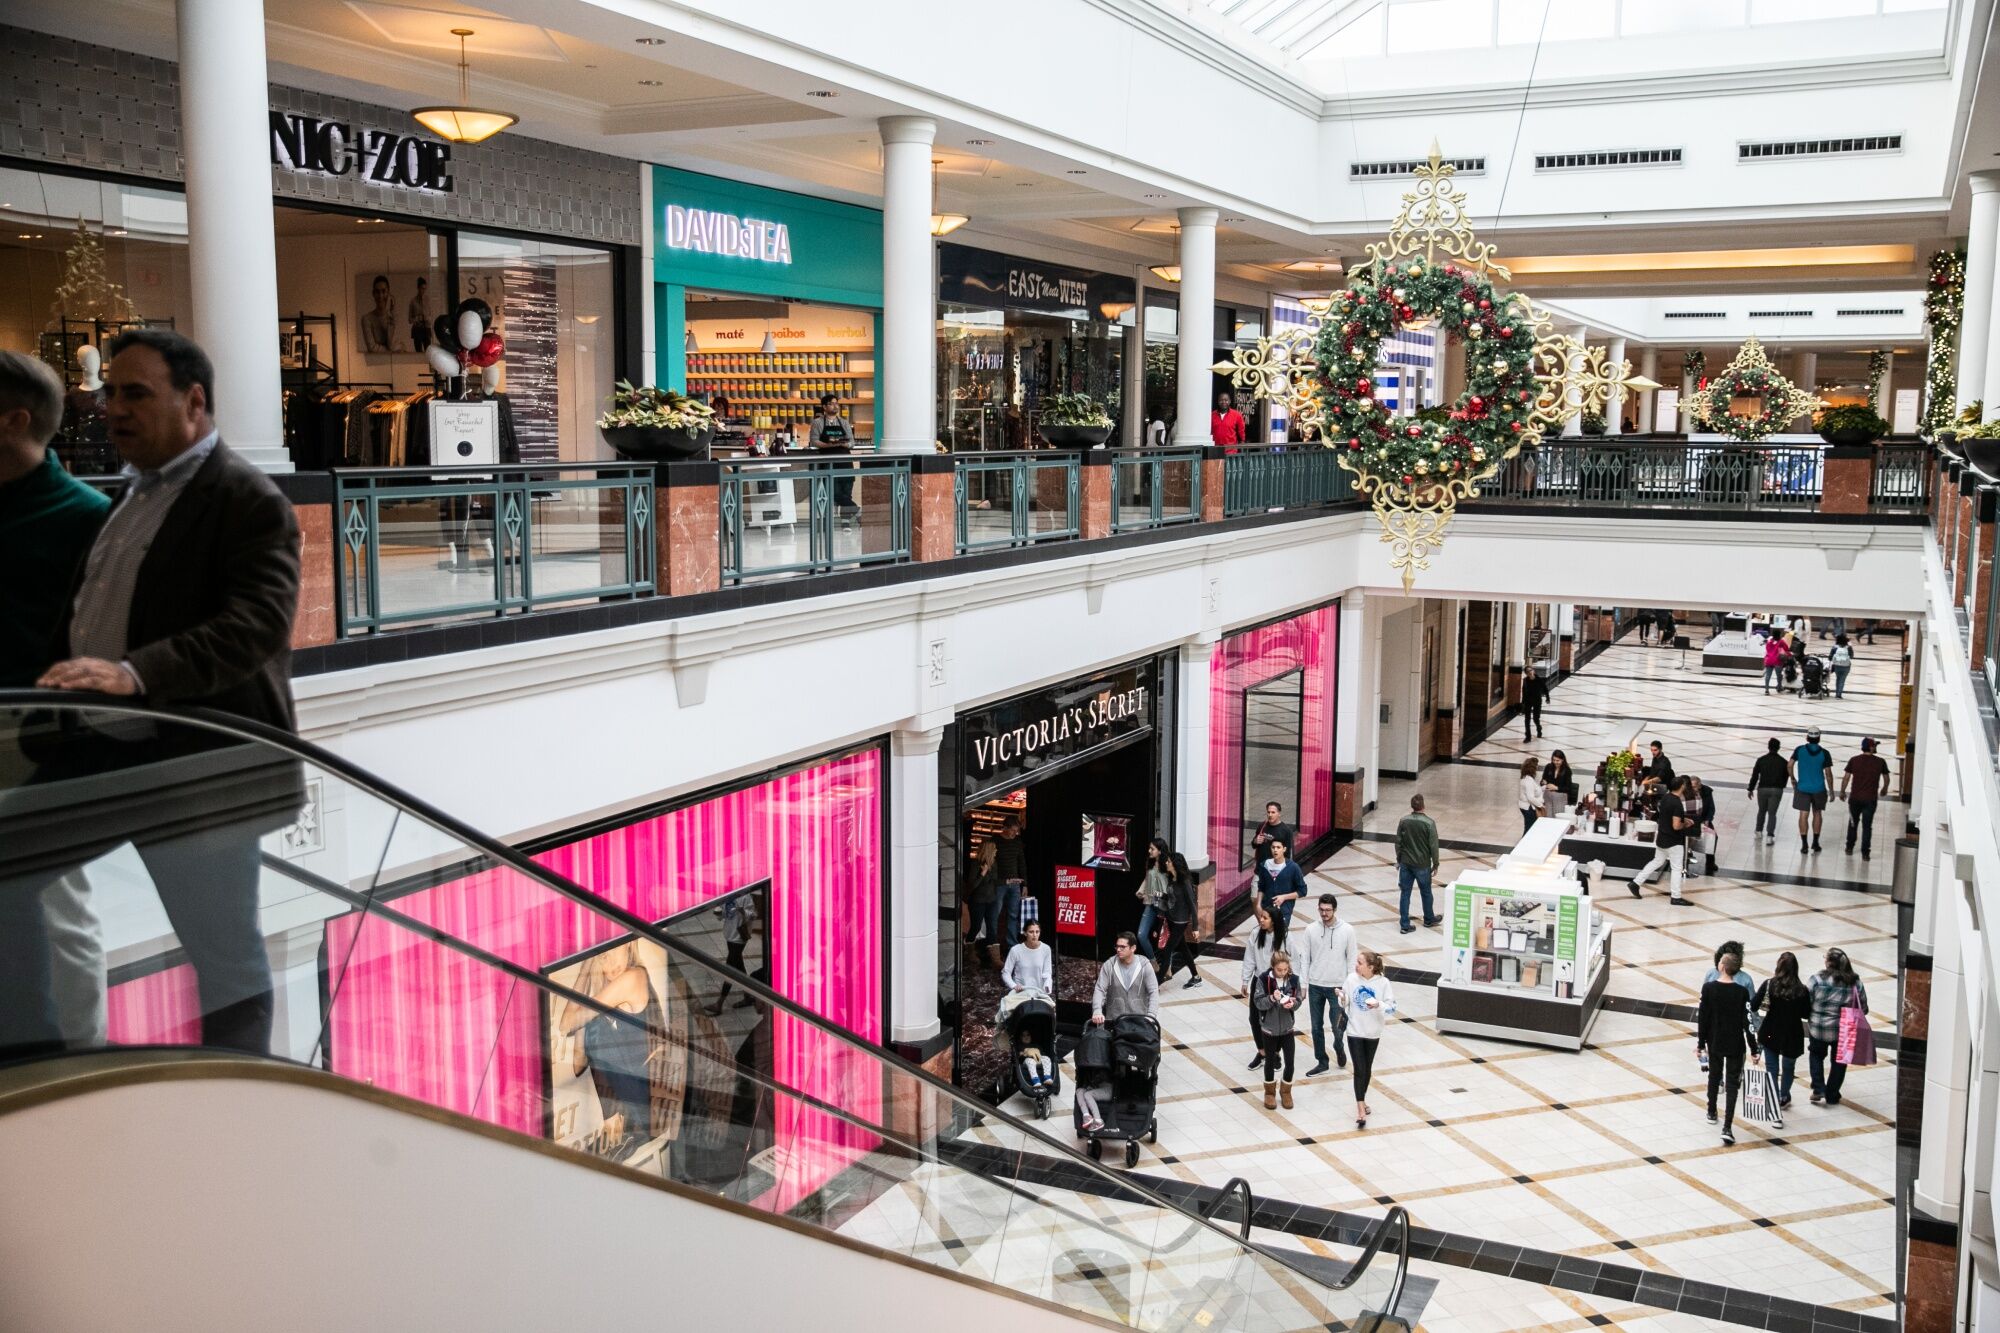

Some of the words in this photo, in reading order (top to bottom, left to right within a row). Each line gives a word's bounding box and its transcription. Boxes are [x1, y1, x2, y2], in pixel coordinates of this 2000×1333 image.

[269, 110, 453, 192] NIC+ZOE
[1009, 269, 1043, 300] EAST
[1059, 279, 1088, 306] WEST
[716, 329, 745, 340] maté
[766, 328, 806, 339] ooibos
[974, 708, 1083, 770] VICTORIA'S
[1088, 686, 1145, 729] SECRET
[1068, 881, 1080, 889] SALE
[1080, 880, 1095, 888] EVER!
[1058, 909, 1087, 924] FREE
